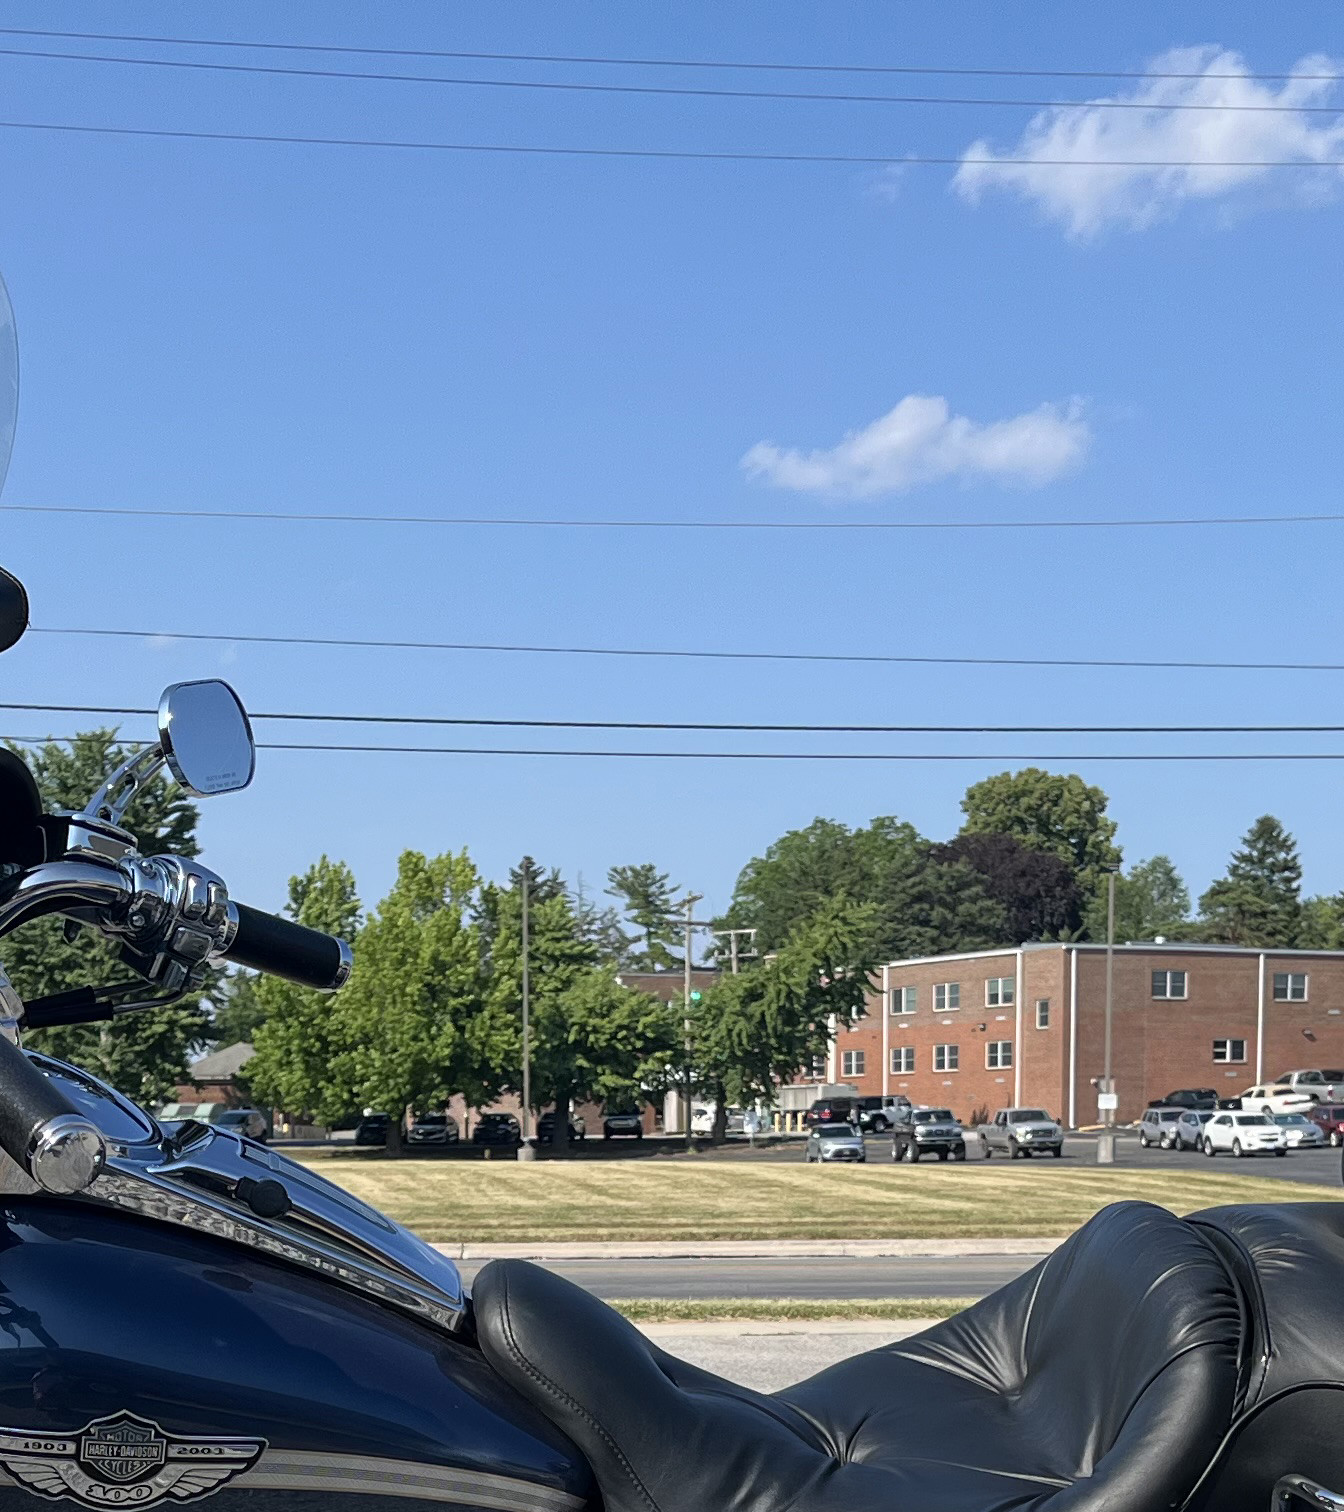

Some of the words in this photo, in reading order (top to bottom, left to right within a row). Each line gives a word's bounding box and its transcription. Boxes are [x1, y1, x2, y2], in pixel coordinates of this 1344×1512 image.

[106, 1429, 149, 1442] MOTOR
[22, 1442, 68, 1452] 1903
[88, 1444, 160, 1458] HARLEY-DAVIDSON
[105, 1459, 142, 1475] CYCLES
